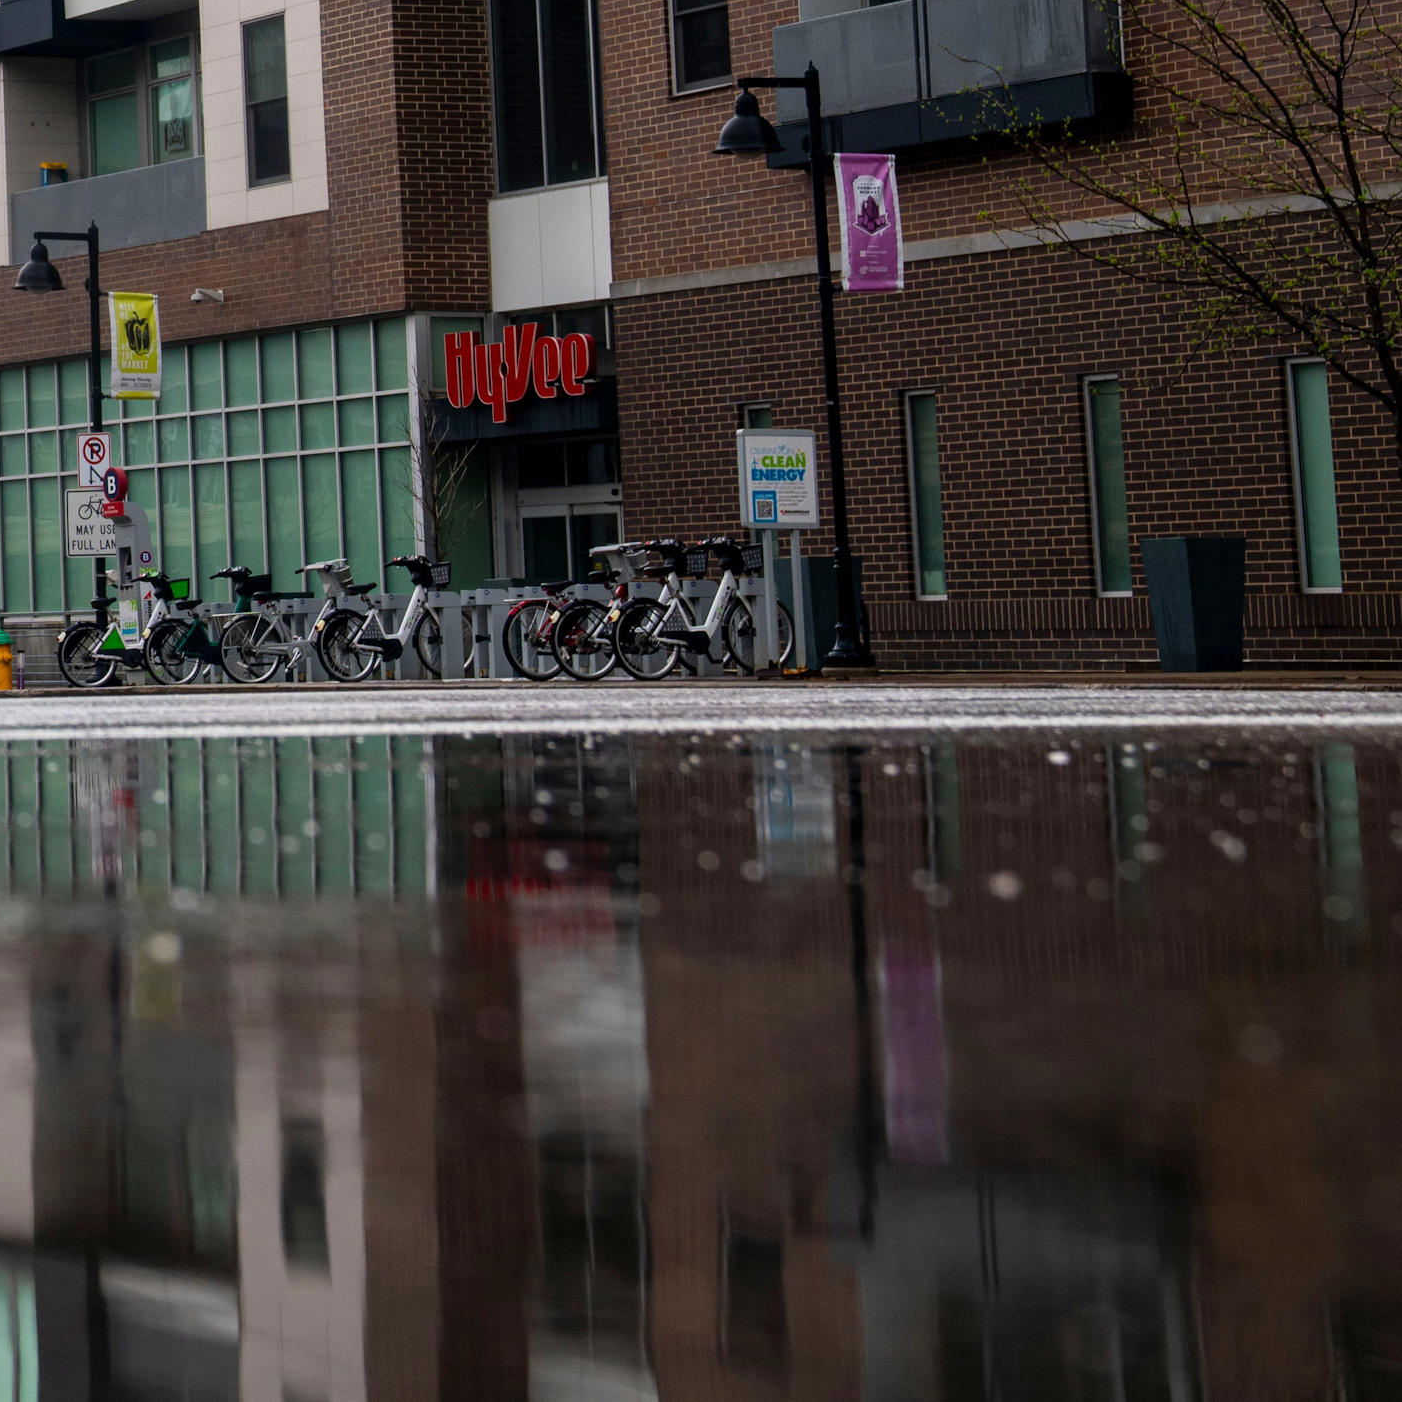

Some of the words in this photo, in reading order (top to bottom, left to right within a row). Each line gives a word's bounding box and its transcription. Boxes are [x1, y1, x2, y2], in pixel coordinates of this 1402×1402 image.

[762, 452, 806, 468] CLEAN
[751, 469, 806, 481] ENERGY
[107, 476, 116, 495] B
[76, 525, 95, 535] MAY
[72, 540, 95, 551] FULL
[100, 540, 116, 550] LAN
[142, 554, 150, 562] B
